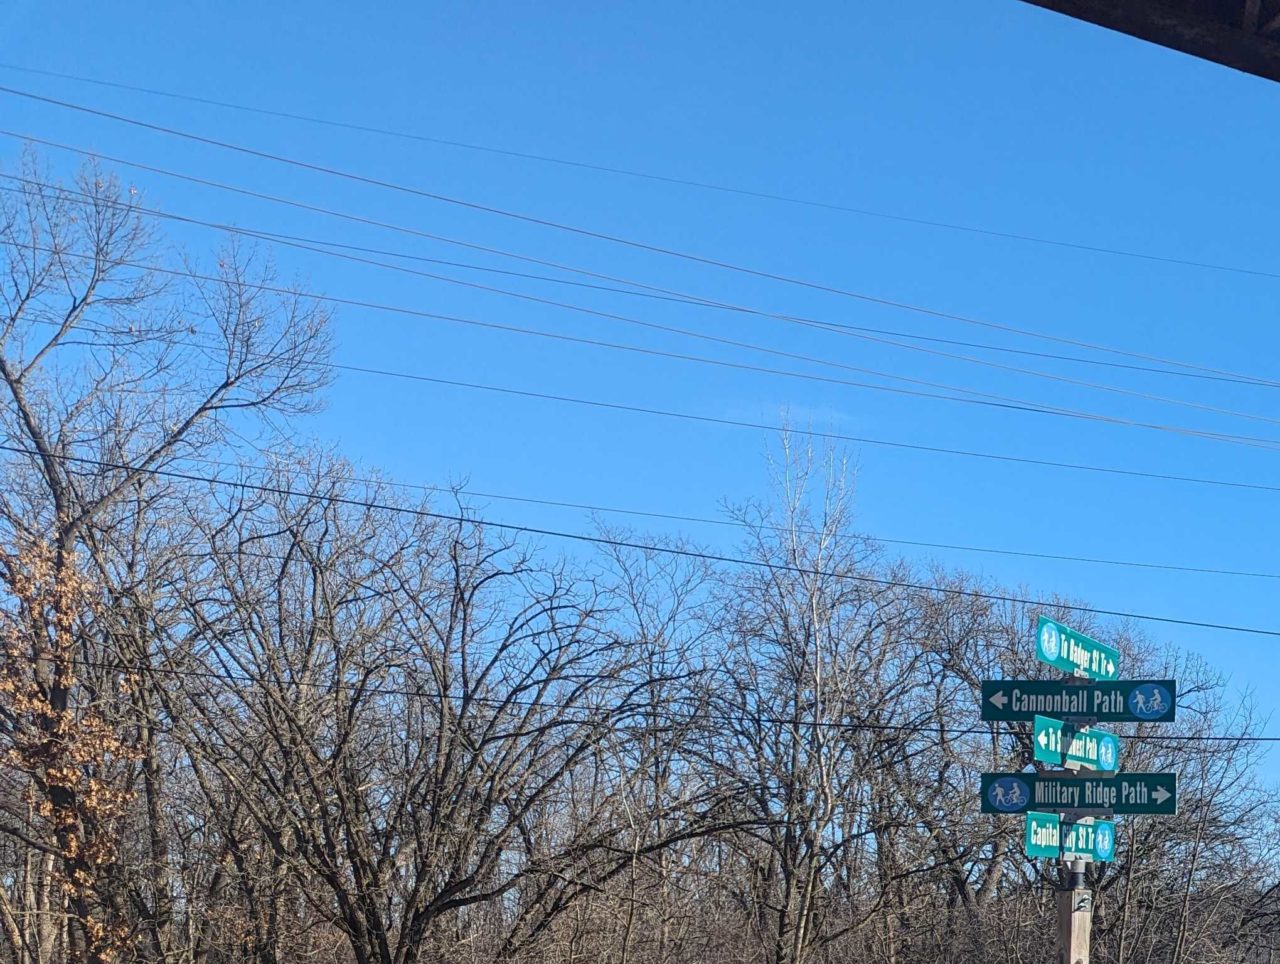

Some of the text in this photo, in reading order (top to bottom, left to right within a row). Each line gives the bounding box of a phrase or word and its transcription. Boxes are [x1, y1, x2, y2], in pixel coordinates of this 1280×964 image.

[1060, 634, 1107, 676] To Badger St Tr
[1012, 689, 1124, 713] Cannonball Path
[1049, 728, 1056, 751] To
[1086, 736, 1097, 760] Path
[1035, 782, 1148, 808] Military Ridge Path
[1031, 821, 1094, 852] Capital City St Tr
